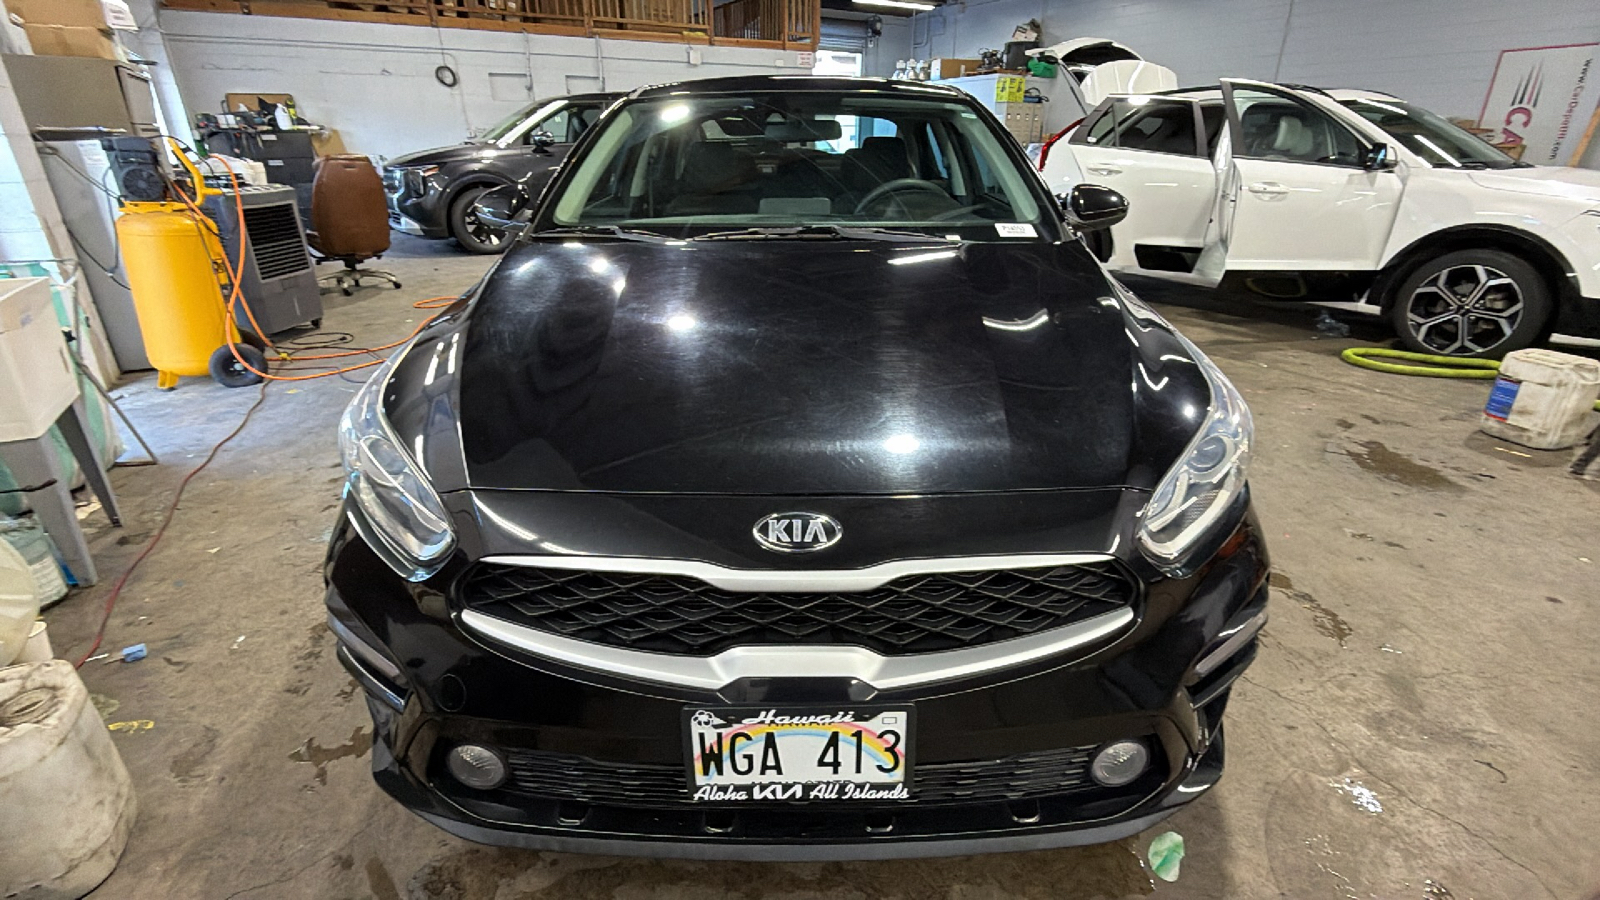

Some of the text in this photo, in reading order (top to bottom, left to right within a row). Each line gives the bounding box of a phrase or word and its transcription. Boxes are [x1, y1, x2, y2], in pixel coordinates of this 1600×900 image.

[1503, 106, 1532, 146] CA
[768, 519, 827, 543] KIA
[741, 709, 855, 725] Hawaii
[698, 729, 901, 777] WGA 413
[693, 783, 748, 801] Aloha
[809, 783, 839, 799] All
[841, 783, 909, 800] Islands
